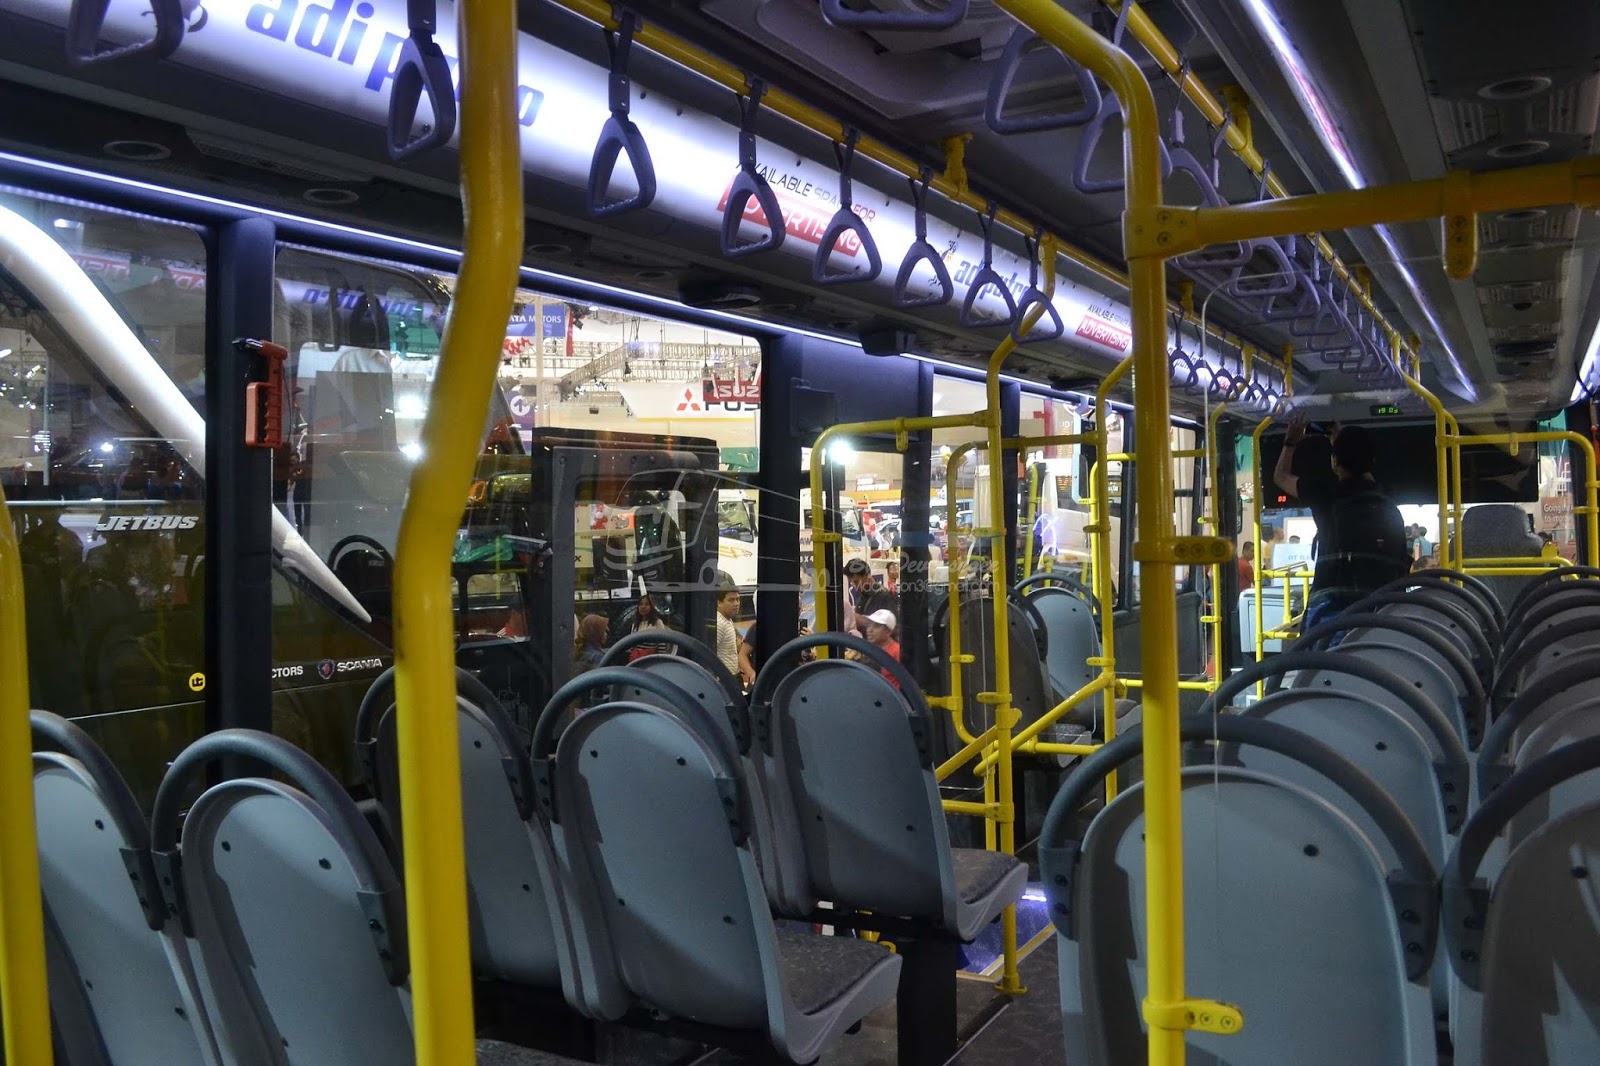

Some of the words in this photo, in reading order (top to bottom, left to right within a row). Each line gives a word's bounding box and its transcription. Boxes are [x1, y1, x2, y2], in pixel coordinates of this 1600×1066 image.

[853, 204, 876, 223] FOR
[528, 314, 562, 323] MTORS
[95, 515, 199, 531] JETBUS
[336, 658, 383, 672] SCANIA
